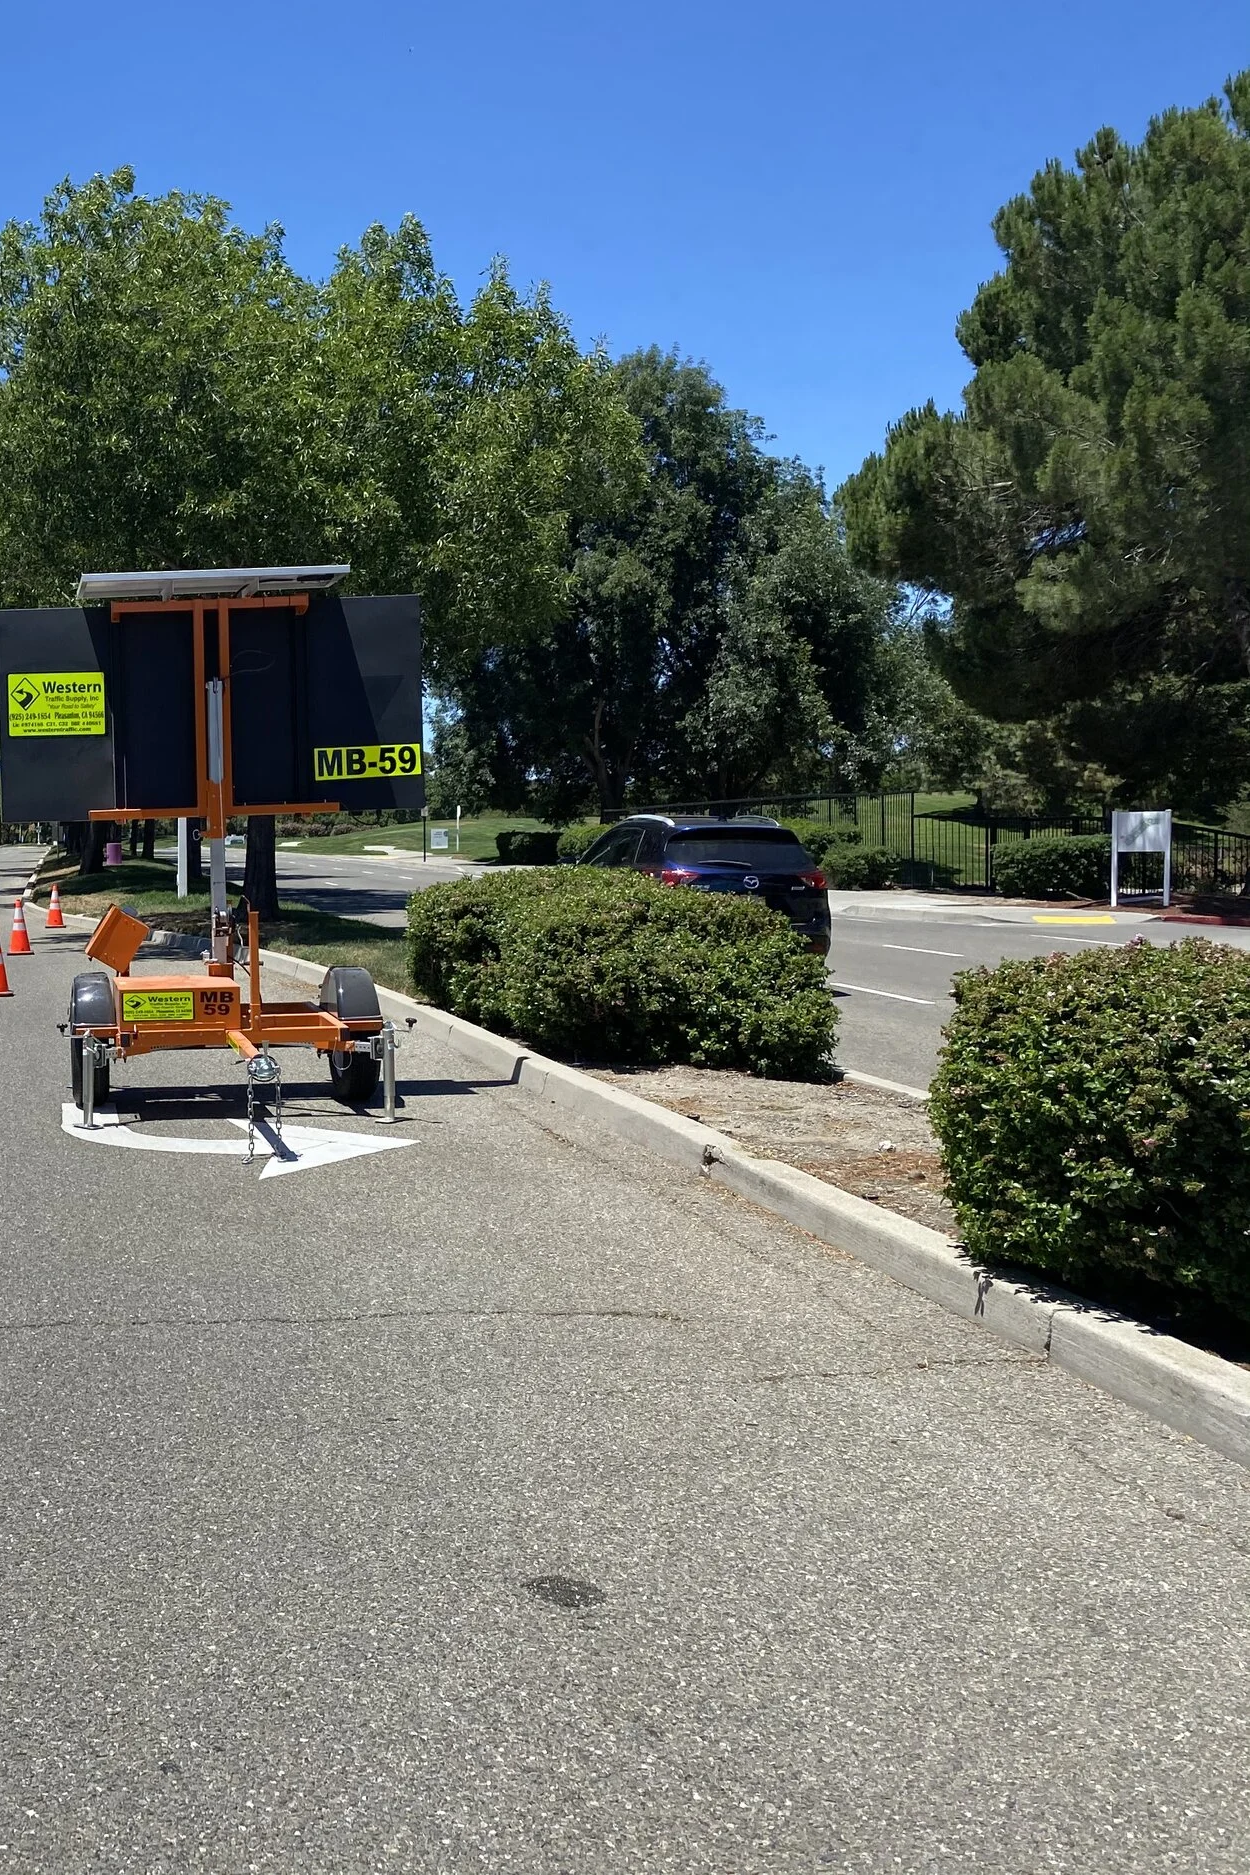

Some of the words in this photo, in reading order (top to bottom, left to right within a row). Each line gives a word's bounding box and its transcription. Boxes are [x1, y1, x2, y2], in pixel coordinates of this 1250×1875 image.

[42, 681, 102, 694] Western
[66, 695, 88, 703] Supply,
[9, 713, 24, 721] (925)
[317, 745, 417, 777] MB-59
[200, 991, 234, 1003] MB
[204, 1003, 230, 1016] 59
